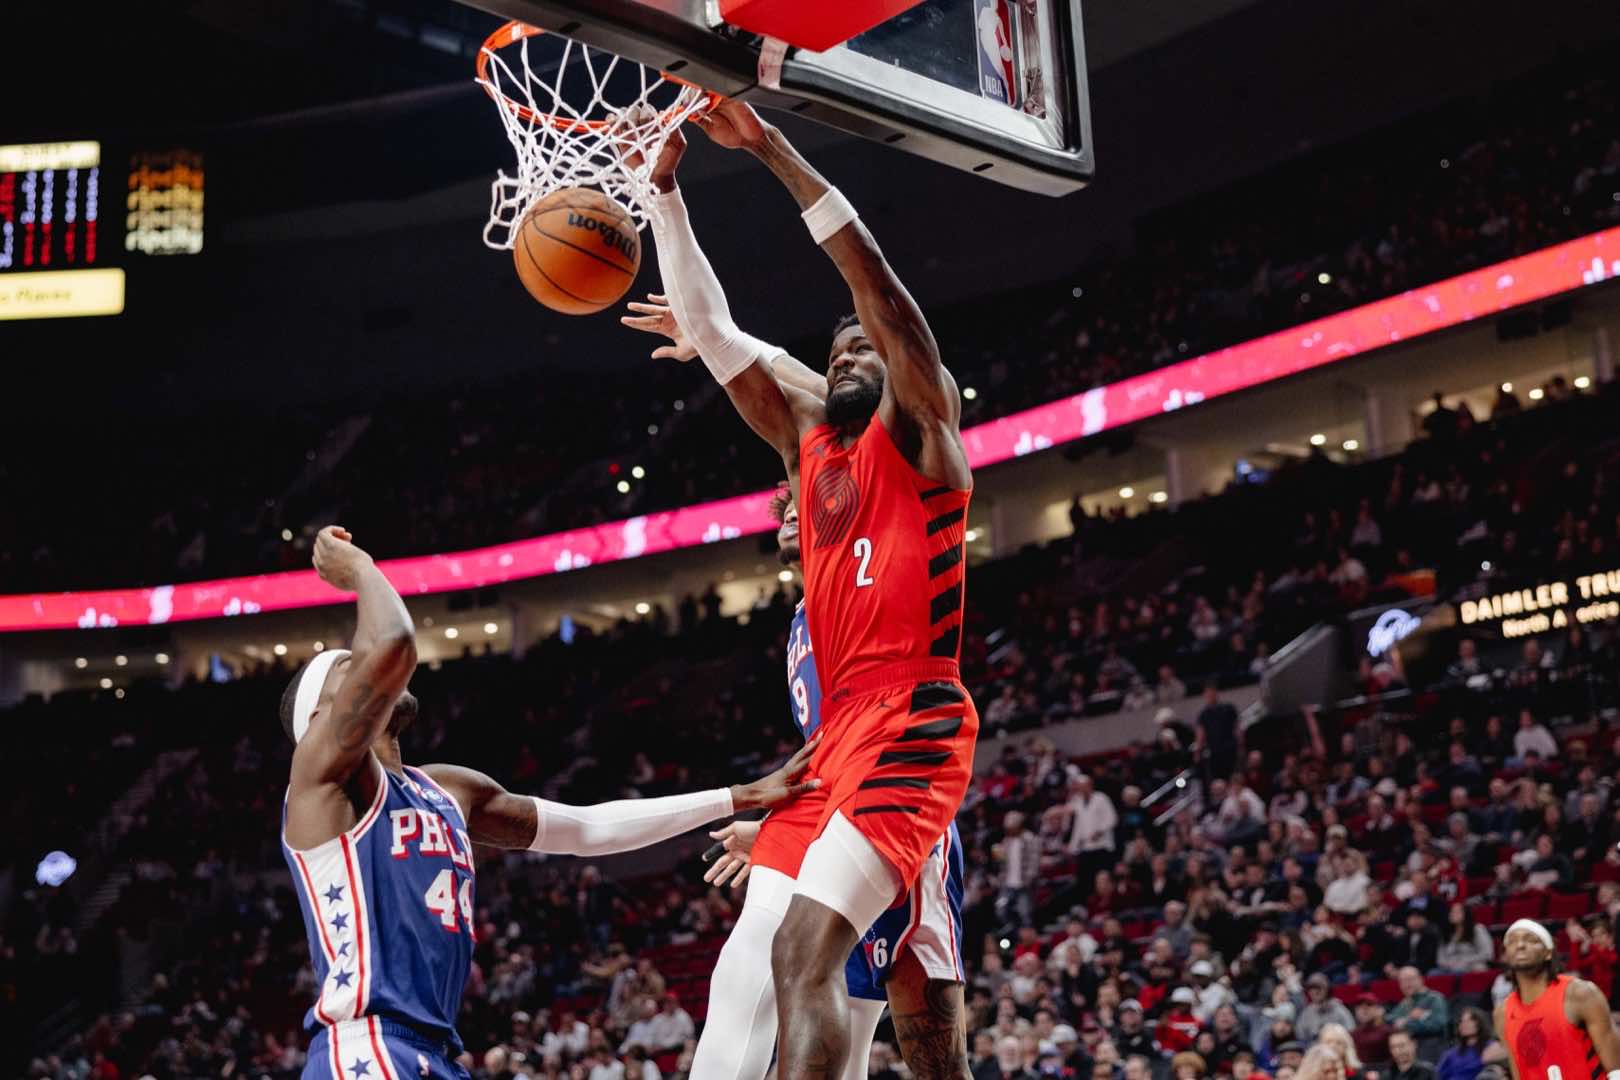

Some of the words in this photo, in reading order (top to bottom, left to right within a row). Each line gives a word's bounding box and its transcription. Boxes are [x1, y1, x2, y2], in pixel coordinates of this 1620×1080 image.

[985, 75, 1003, 97] NBA
[567, 211, 637, 262] Wilson
[853, 537, 874, 588] 2
[1460, 581, 1568, 624] DAIMLER
[792, 676, 809, 727] 9
[424, 868, 477, 943] 44
